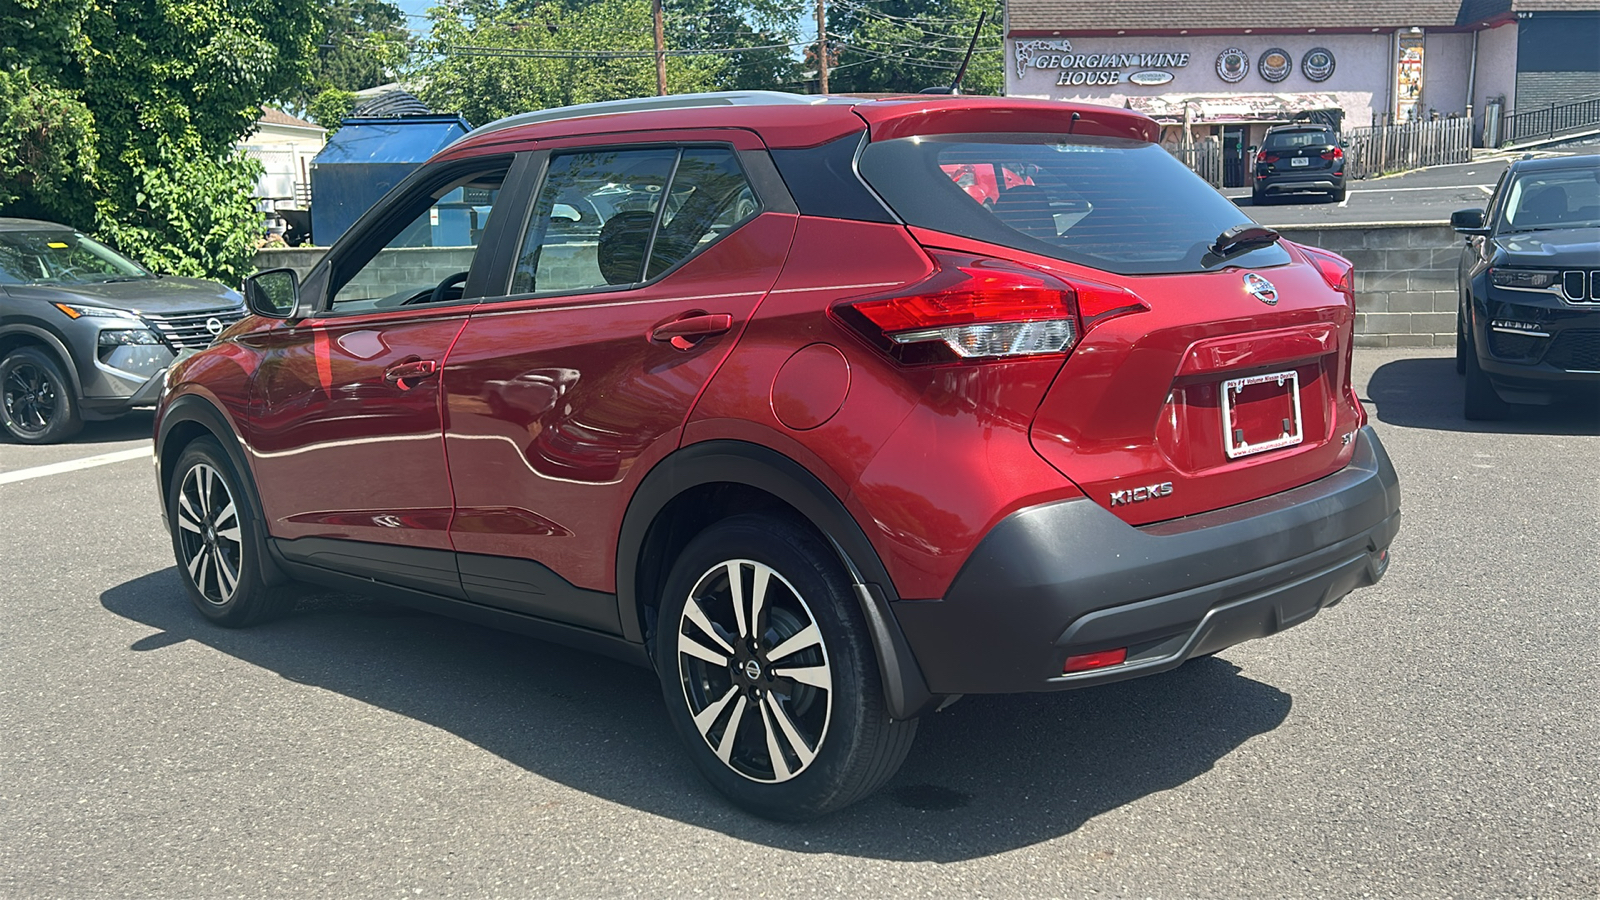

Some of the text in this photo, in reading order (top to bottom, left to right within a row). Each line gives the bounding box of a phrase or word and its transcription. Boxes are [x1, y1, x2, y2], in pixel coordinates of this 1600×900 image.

[1035, 53, 1190, 68] GEORGIAN WINE
[1056, 71, 1121, 86] HOUSE
[1110, 481, 1174, 507] KICKS
